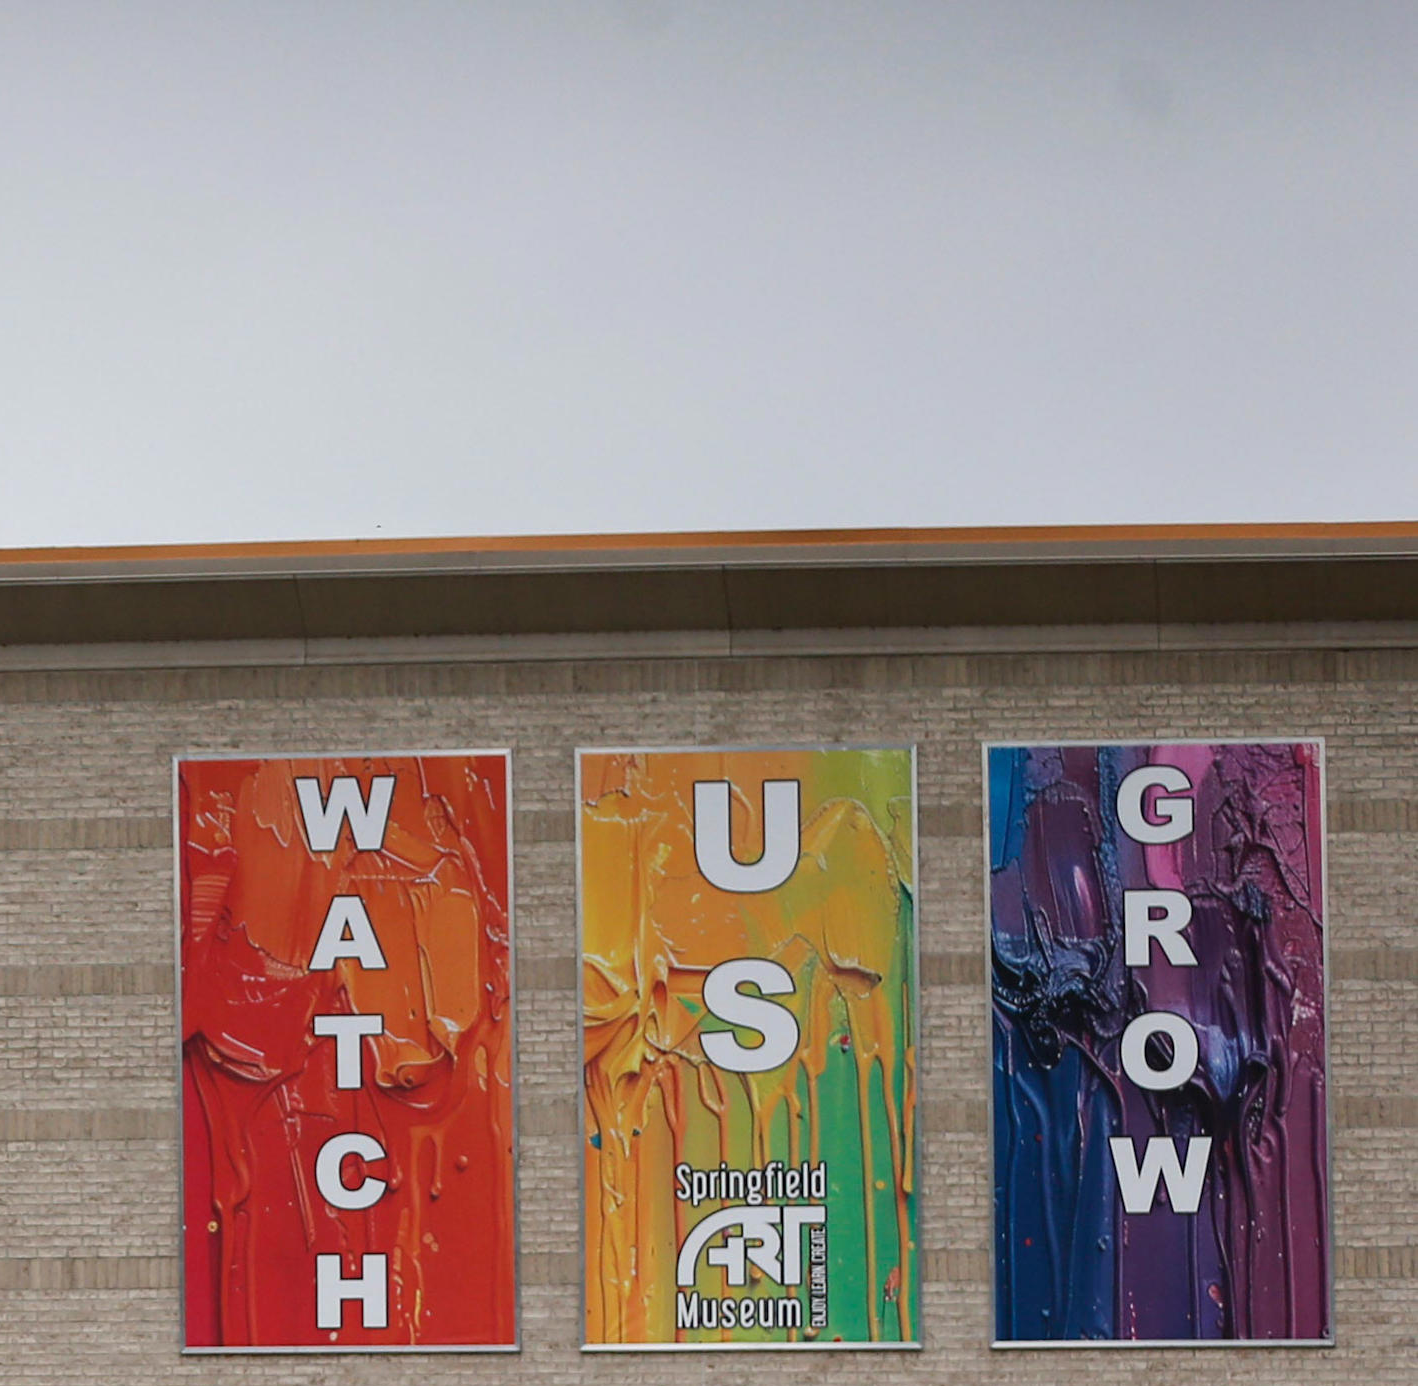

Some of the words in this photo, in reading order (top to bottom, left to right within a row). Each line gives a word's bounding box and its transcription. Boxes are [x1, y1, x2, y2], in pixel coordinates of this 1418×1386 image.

[693, 779, 801, 1073] US
[1108, 765, 1213, 1214] GROW
[294, 775, 396, 1329] WATCH
[675, 1161, 827, 1207] Springfield
[676, 1205, 827, 1287] ART
[676, 1291, 803, 1329] Museum
